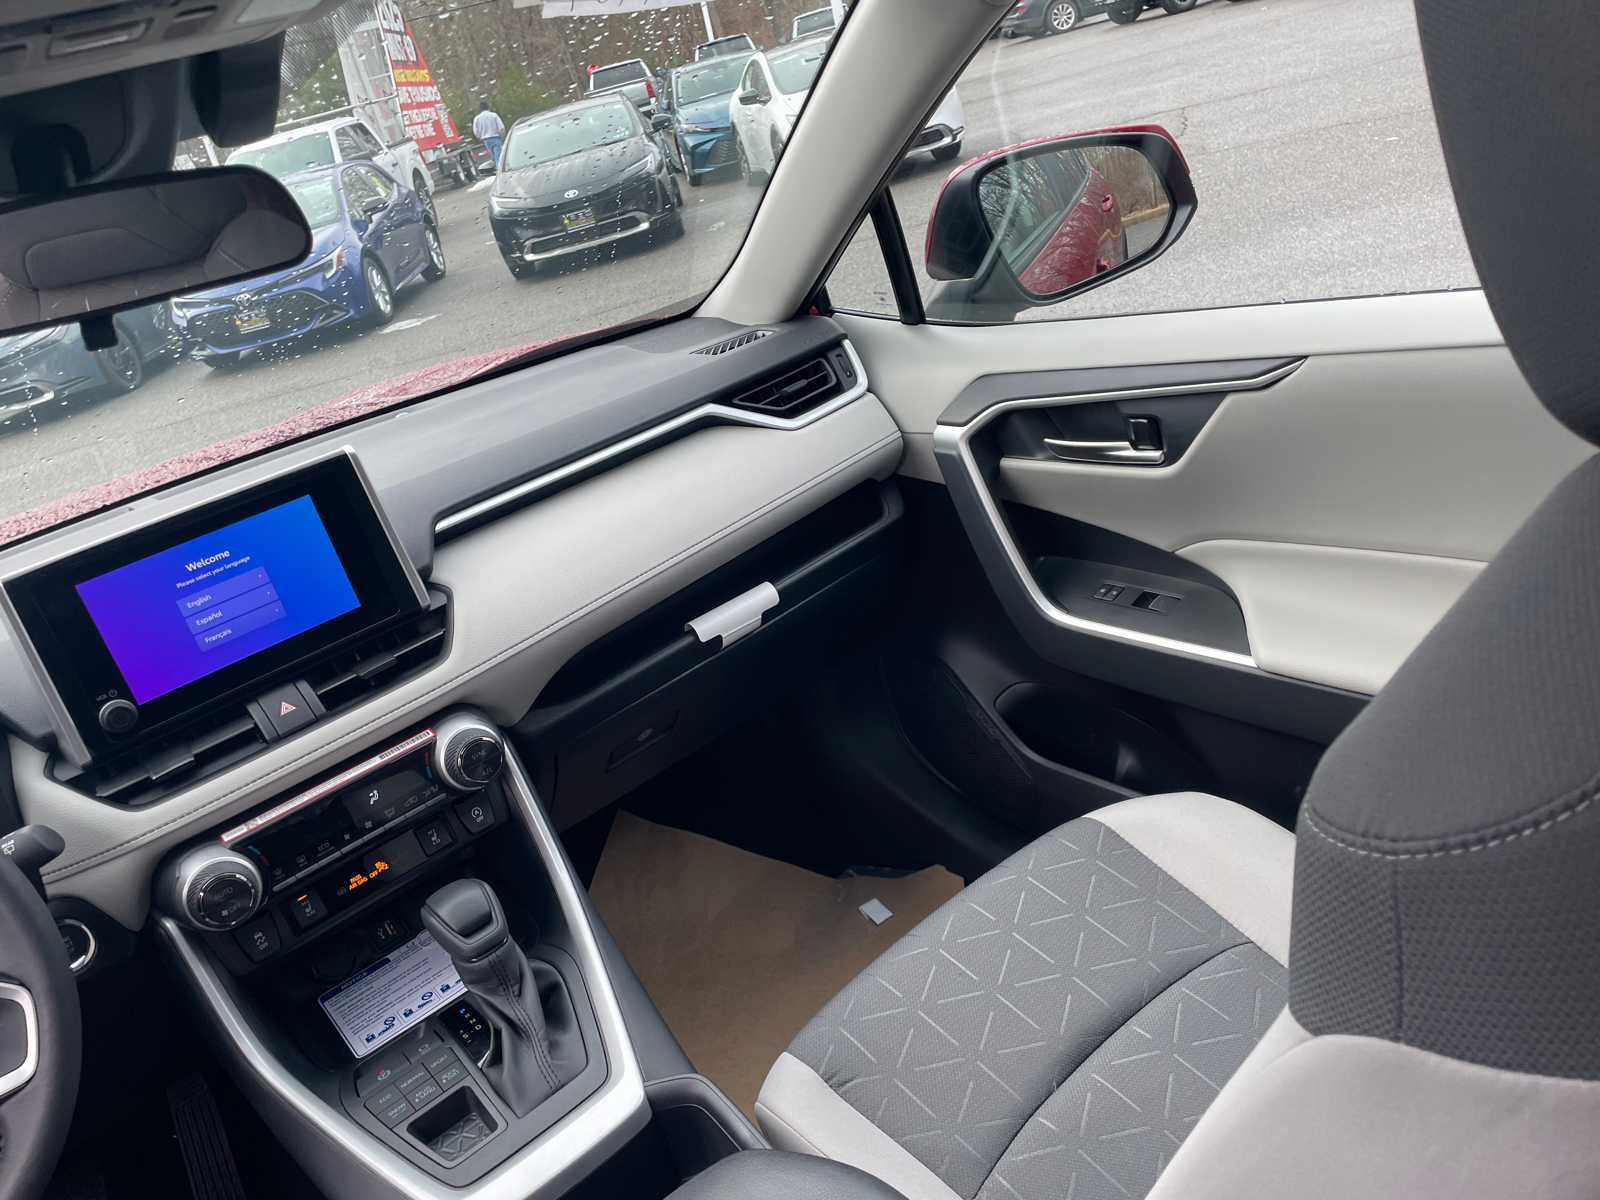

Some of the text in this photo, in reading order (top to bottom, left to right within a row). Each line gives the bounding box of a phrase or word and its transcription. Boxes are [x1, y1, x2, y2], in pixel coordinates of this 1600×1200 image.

[185, 549, 231, 573] Welcome
[176, 555, 251, 589] Please select your language
[187, 594, 212, 609] English
[195, 610, 223, 627] Español
[204, 628, 232, 644] Français
[471, 748, 487, 761] SYNC
[482, 766, 493, 777] A/C
[317, 842, 330, 852] ECO
[213, 886, 234, 901] AUTO
[228, 901, 241, 914] OFF
[340, 970, 369, 990] NOTICE
[430, 1054, 448, 1069] SPORT
[400, 1070, 425, 1089] NORMAL
[378, 1093, 392, 1104] ECO
[415, 1085, 431, 1098] MUD
[420, 1086, 436, 1100] SAND
[388, 1102, 406, 1117] SNOW
